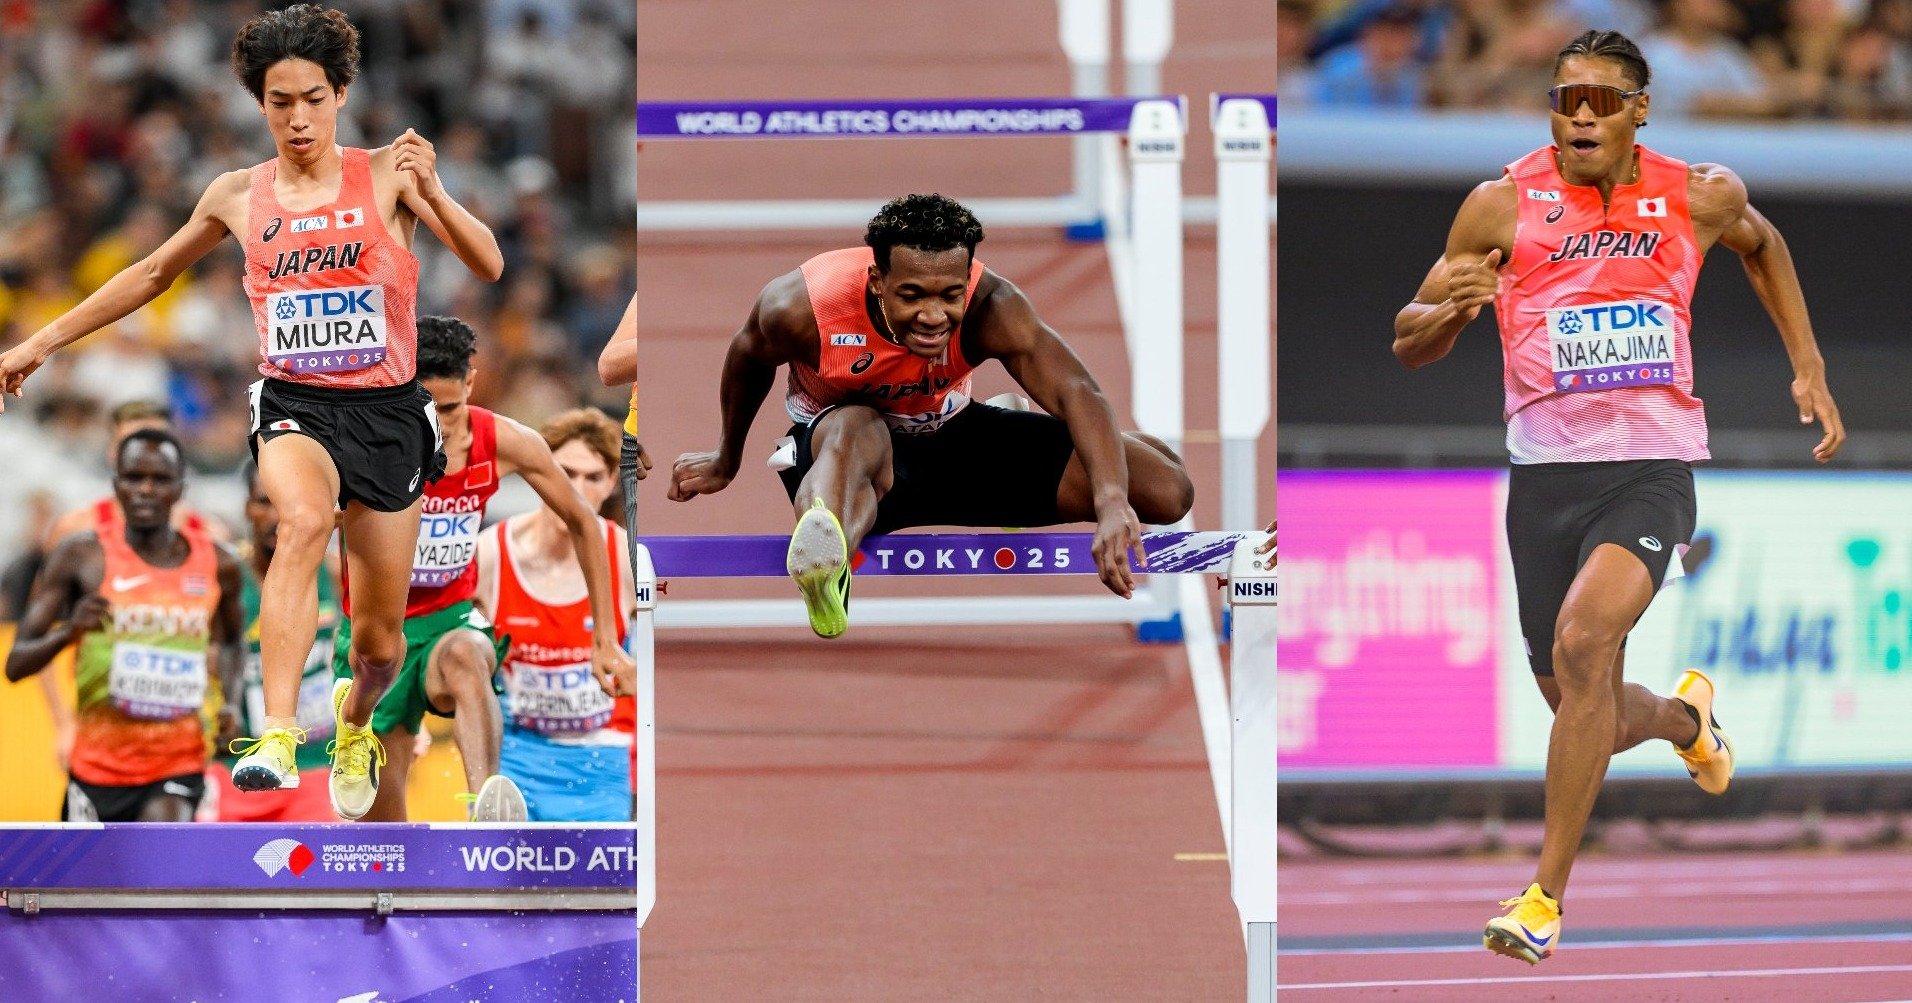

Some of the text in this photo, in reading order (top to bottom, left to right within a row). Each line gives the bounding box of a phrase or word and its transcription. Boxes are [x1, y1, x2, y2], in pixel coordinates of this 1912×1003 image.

[676, 108, 1084, 133] WORLD ATHLETICS CHAMPIONSHIPS
[294, 217, 327, 232] ACN
[1550, 231, 1661, 262] JAPAN
[268, 241, 363, 280] JAPAN
[296, 290, 375, 318] TDK
[1582, 304, 1664, 332] TDK
[276, 319, 378, 350] MIURA
[832, 335, 864, 345] ACN
[1557, 335, 1669, 368] NAKAJIMA
[419, 542, 472, 566] YAZIDE
[1235, 583, 1277, 596] NISH
[322, 845, 406, 853] WORLD ATHLETICS
[322, 853, 406, 862] CHAMPIONSHIPS
[461, 846, 577, 872] WORLD
